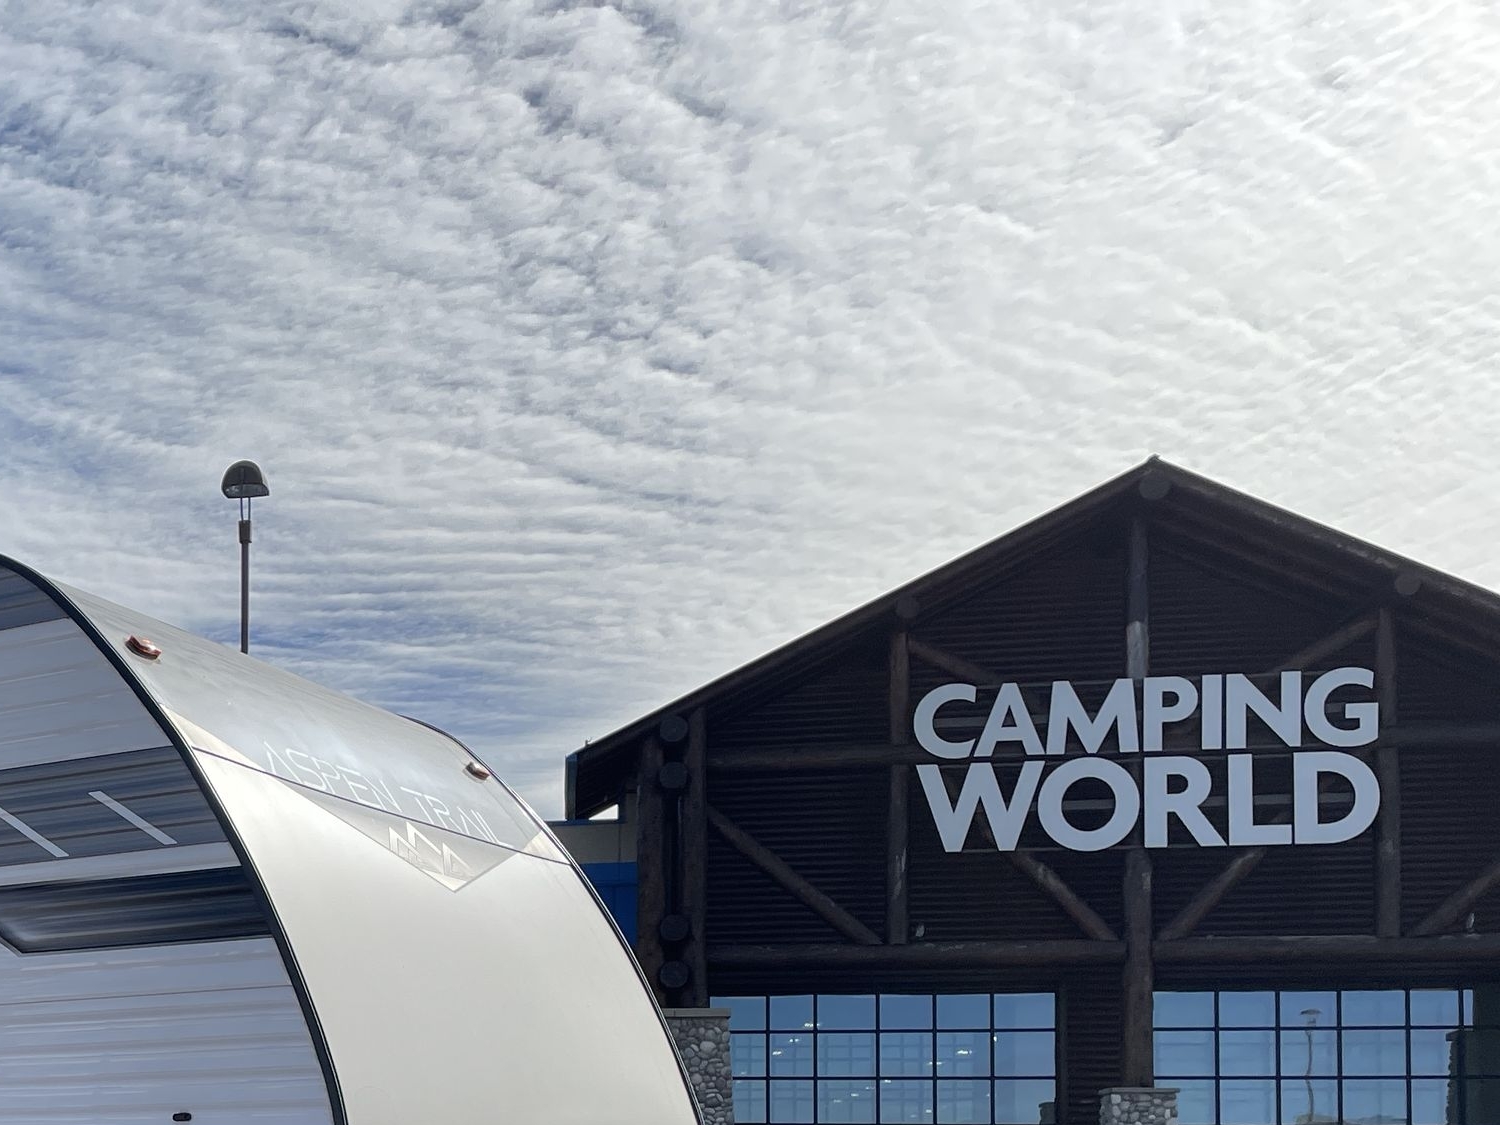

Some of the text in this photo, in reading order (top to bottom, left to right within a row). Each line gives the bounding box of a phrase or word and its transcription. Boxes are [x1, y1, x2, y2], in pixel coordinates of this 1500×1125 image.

[913, 667, 1379, 759] CAMPING
[261, 741, 516, 849] ASPEN TRAIL
[916, 751, 1381, 853] WORLD
